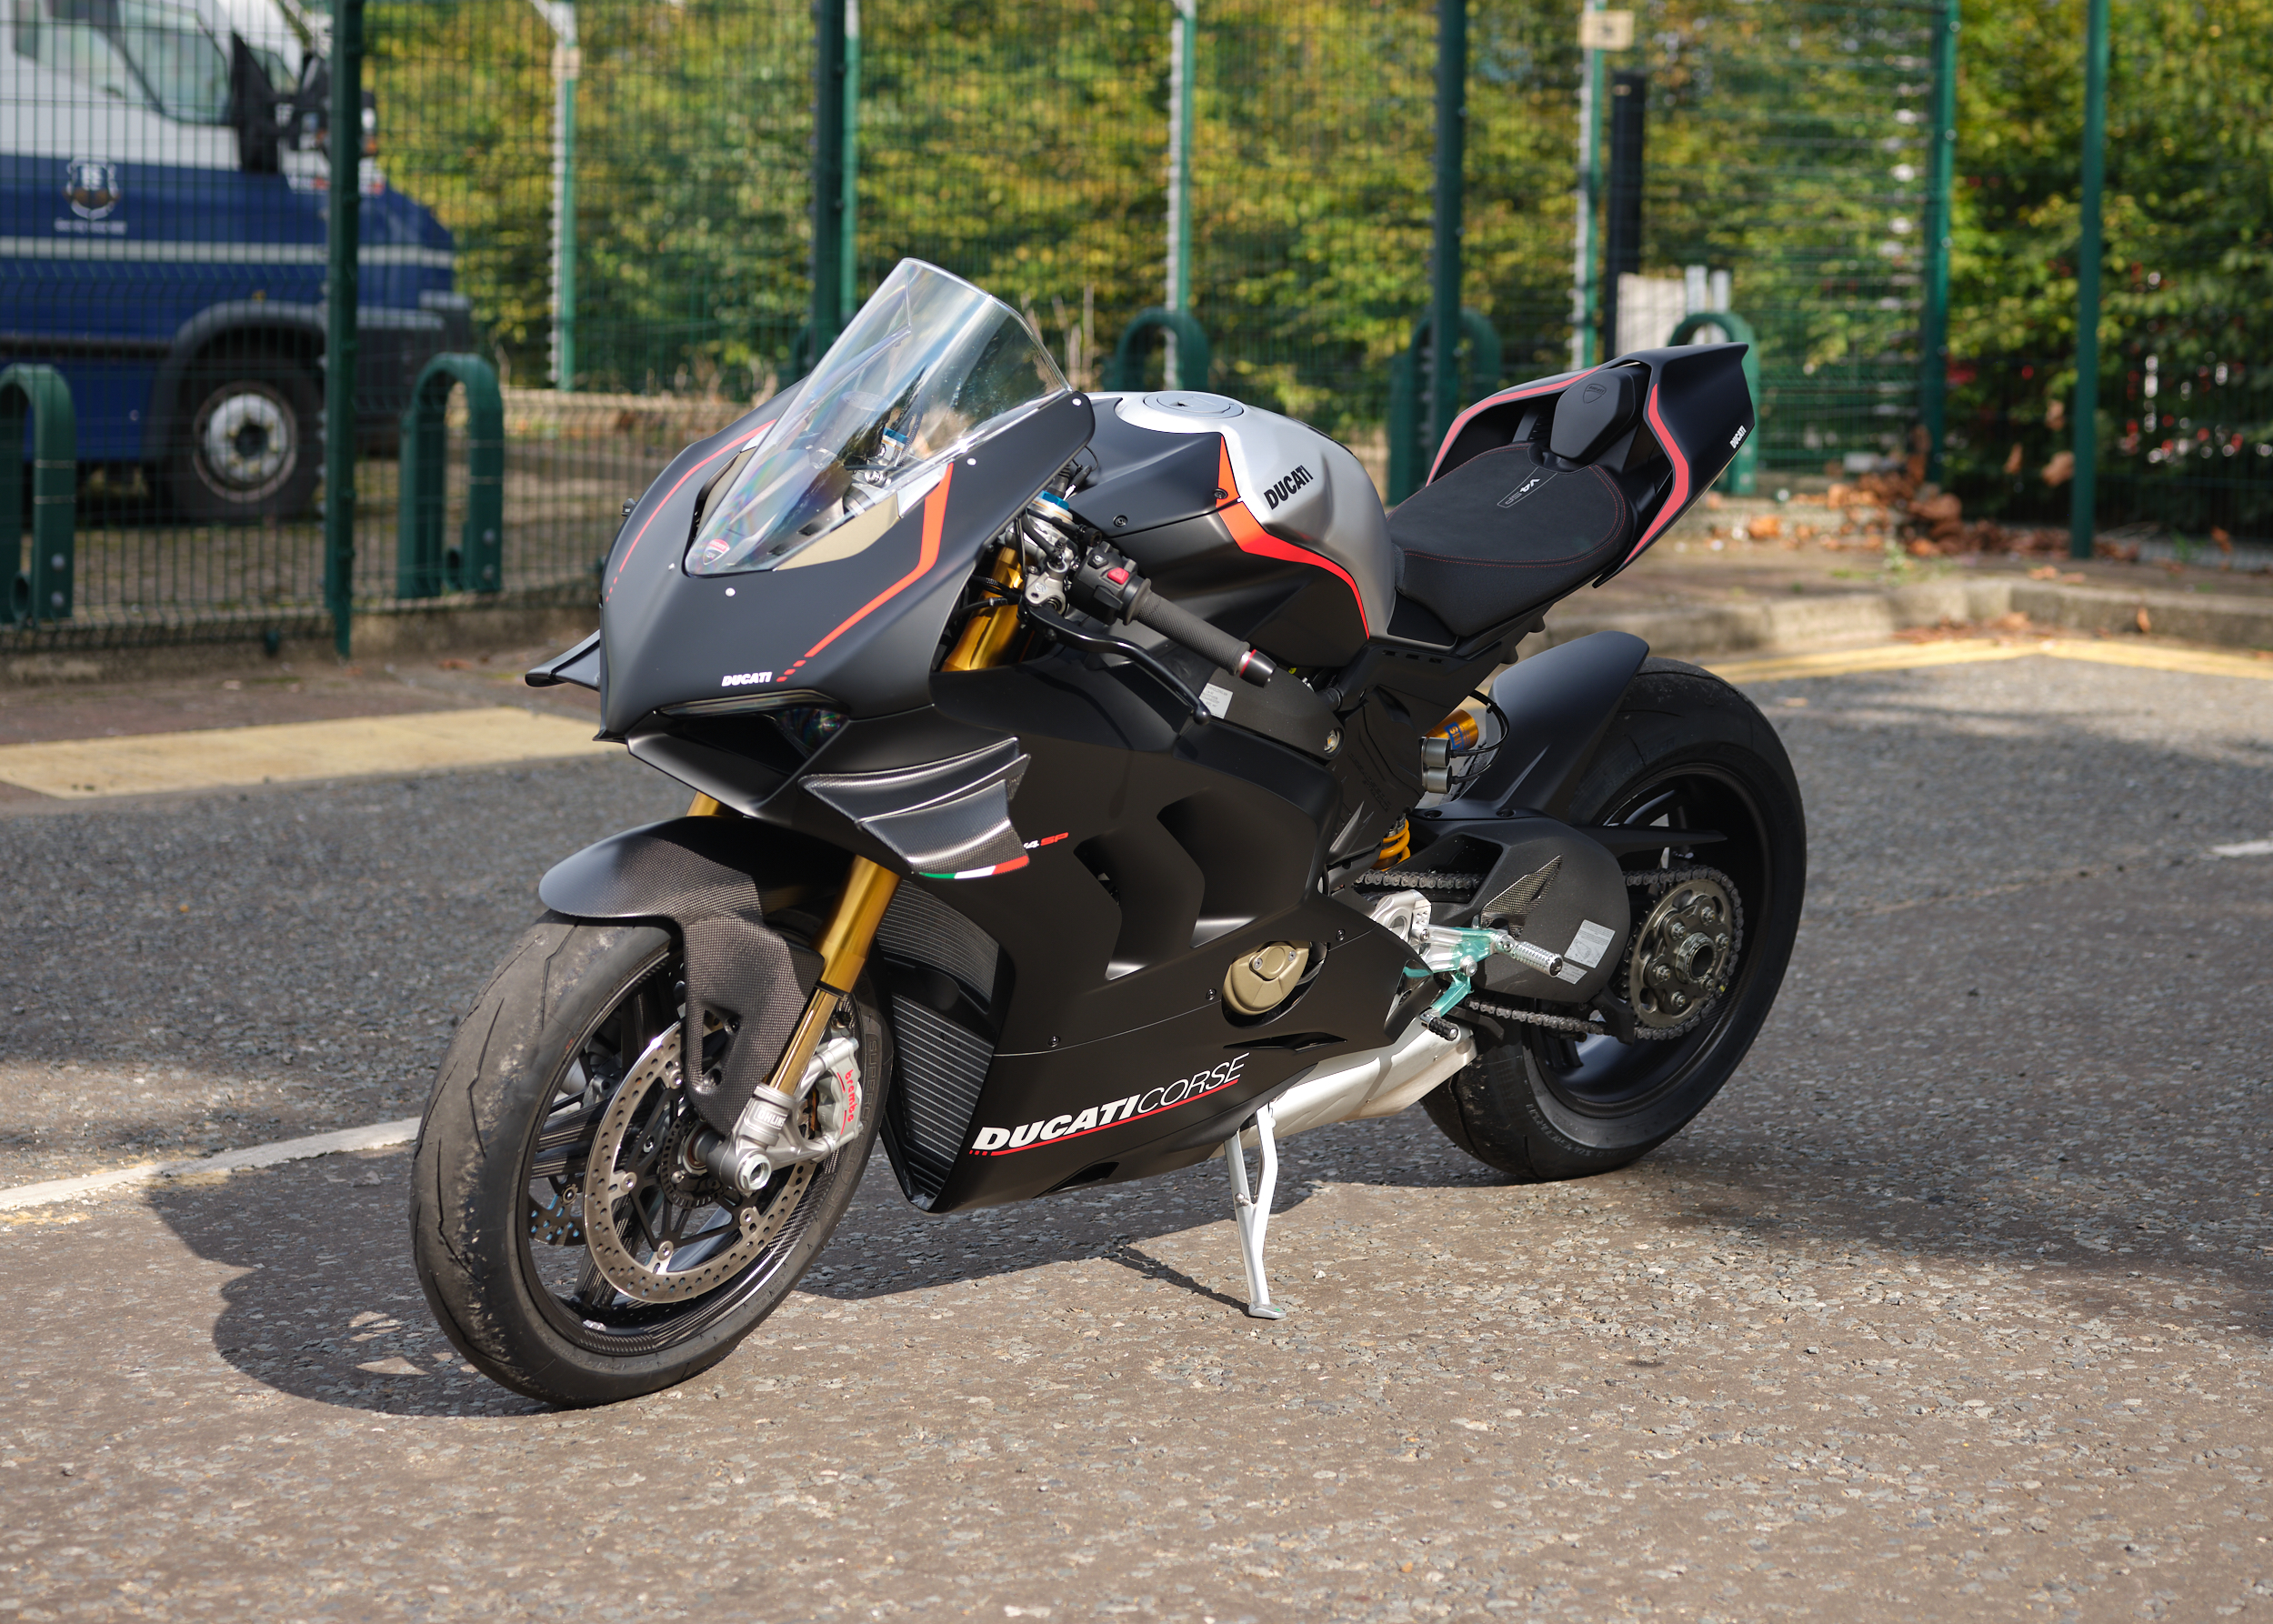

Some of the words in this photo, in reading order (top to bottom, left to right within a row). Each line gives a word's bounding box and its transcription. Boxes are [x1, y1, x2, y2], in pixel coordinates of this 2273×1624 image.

[1729, 425, 1747, 449] DUCATI
[1263, 465, 1314, 510] DUCATI
[1519, 478, 1541, 492] V4
[1505, 491, 1523, 505] SP
[721, 671, 773, 687] DUCATI
[1040, 832, 1069, 846] SP
[845, 1068, 858, 1122] brembo
